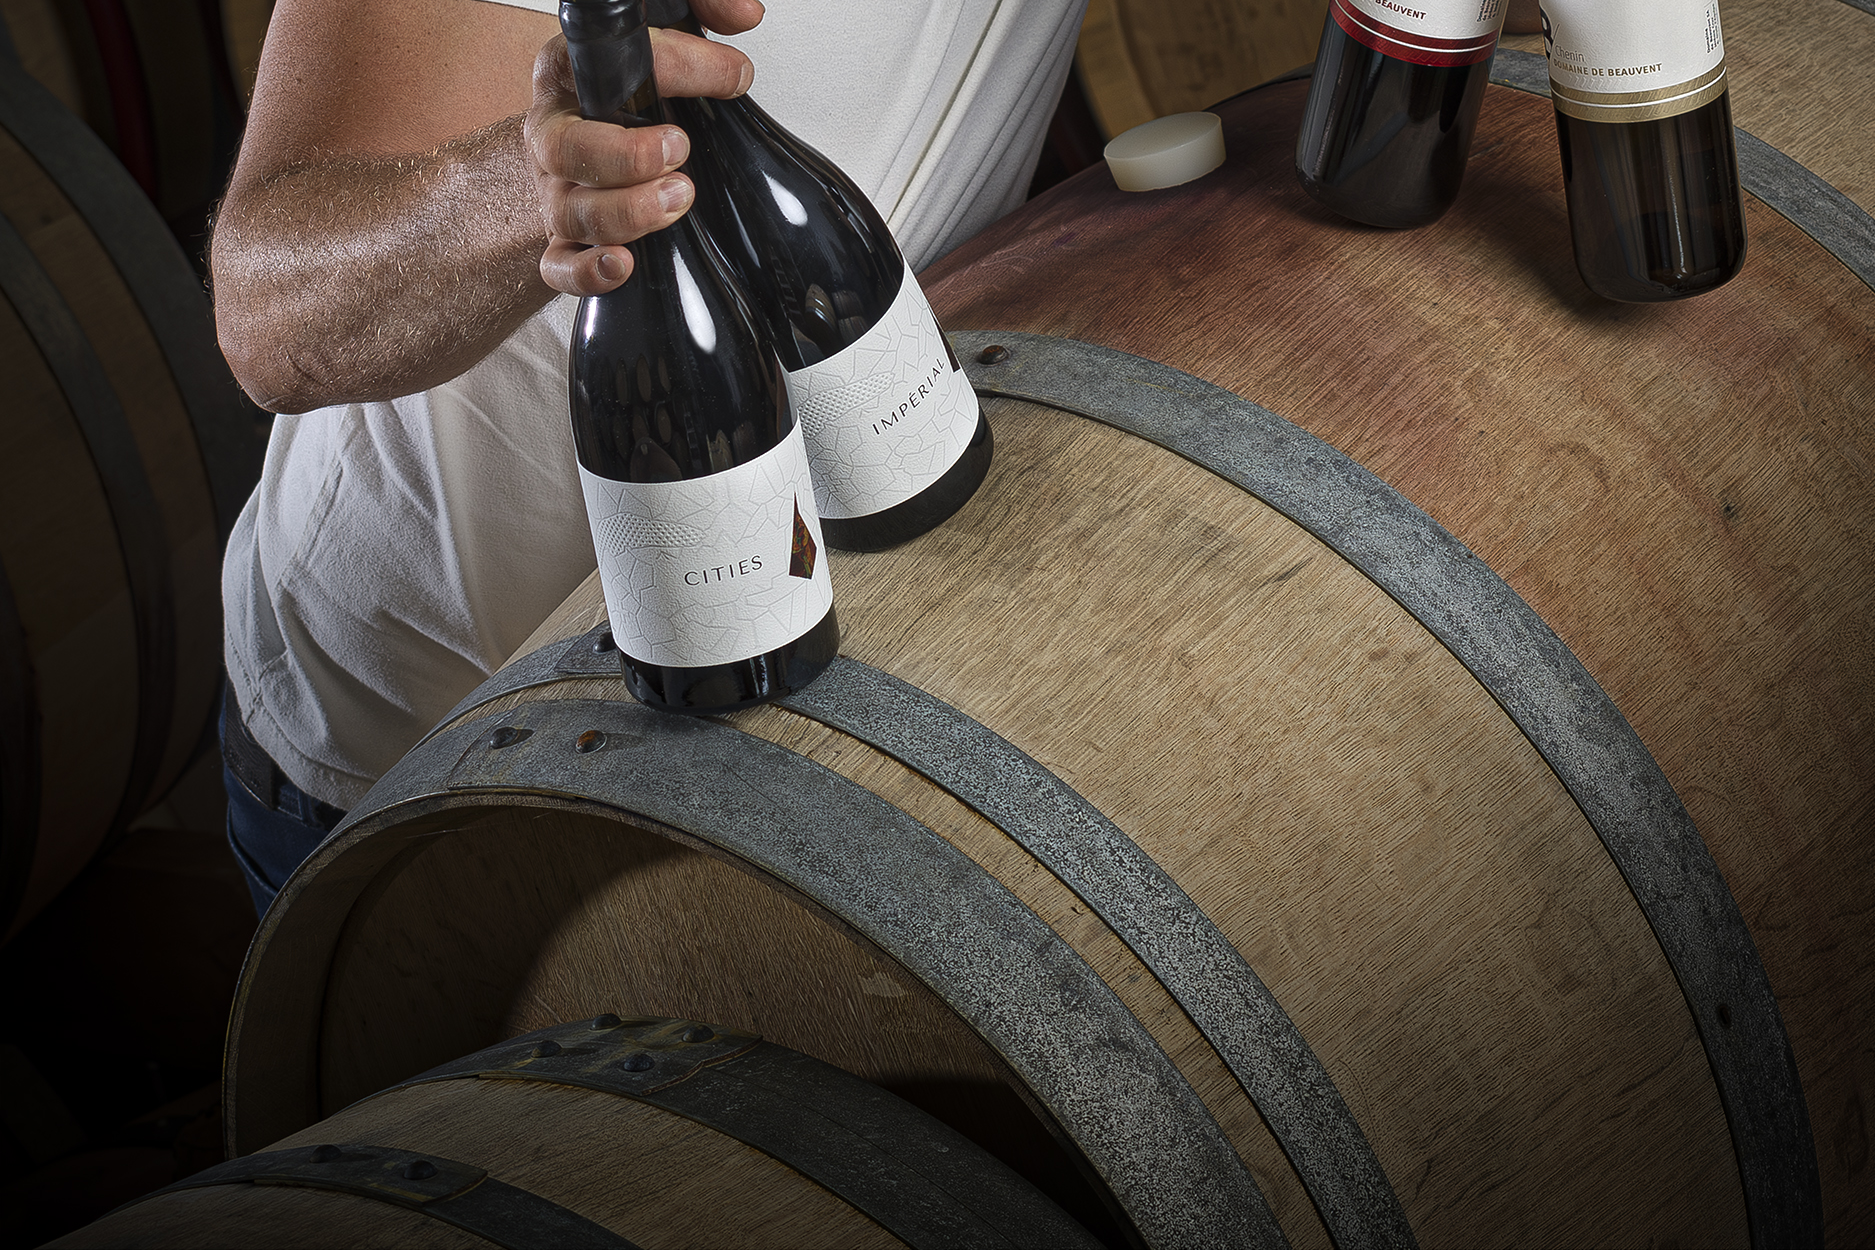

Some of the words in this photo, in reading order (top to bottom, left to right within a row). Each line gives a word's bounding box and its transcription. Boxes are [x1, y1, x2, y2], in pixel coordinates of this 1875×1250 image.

[1555, 45, 1585, 63] Chenin
[1553, 58, 1588, 76] DOMAINE
[1592, 68, 1604, 77] DE
[1608, 62, 1662, 77] BEAUVENT
[872, 358, 945, 435] IMPÉRIAL
[684, 555, 763, 586] CITIES
